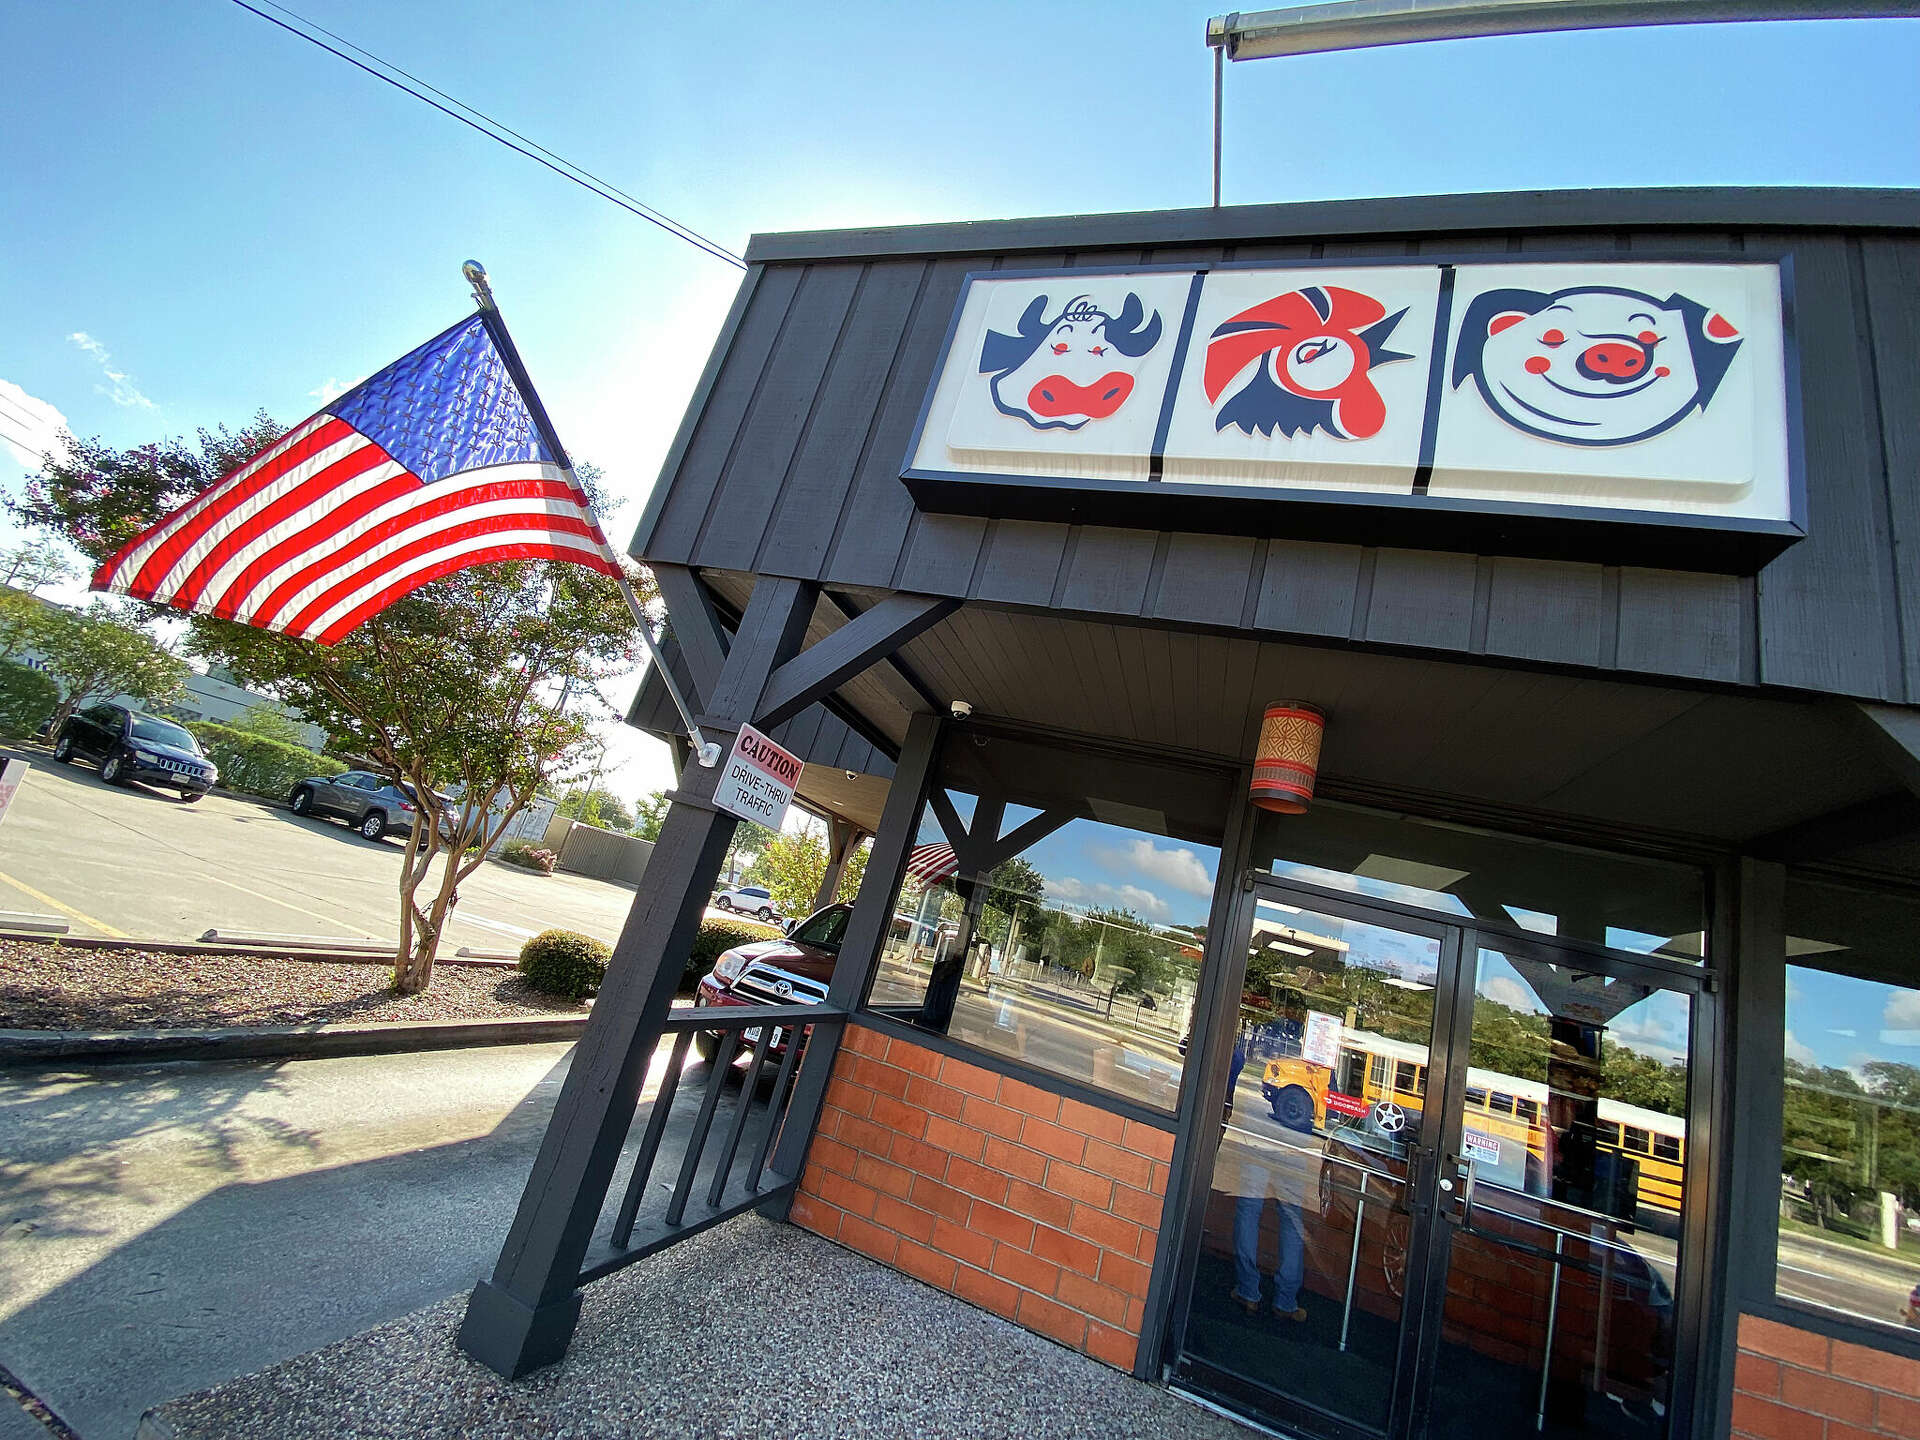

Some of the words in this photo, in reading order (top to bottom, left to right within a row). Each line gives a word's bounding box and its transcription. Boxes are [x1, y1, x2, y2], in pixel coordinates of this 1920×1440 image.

[740, 735, 799, 781] CAUTION
[731, 765, 788, 805] DRIVE-THRU
[735, 787, 774, 817] TRAFFIC
[1467, 1134, 1498, 1151] WARNING
